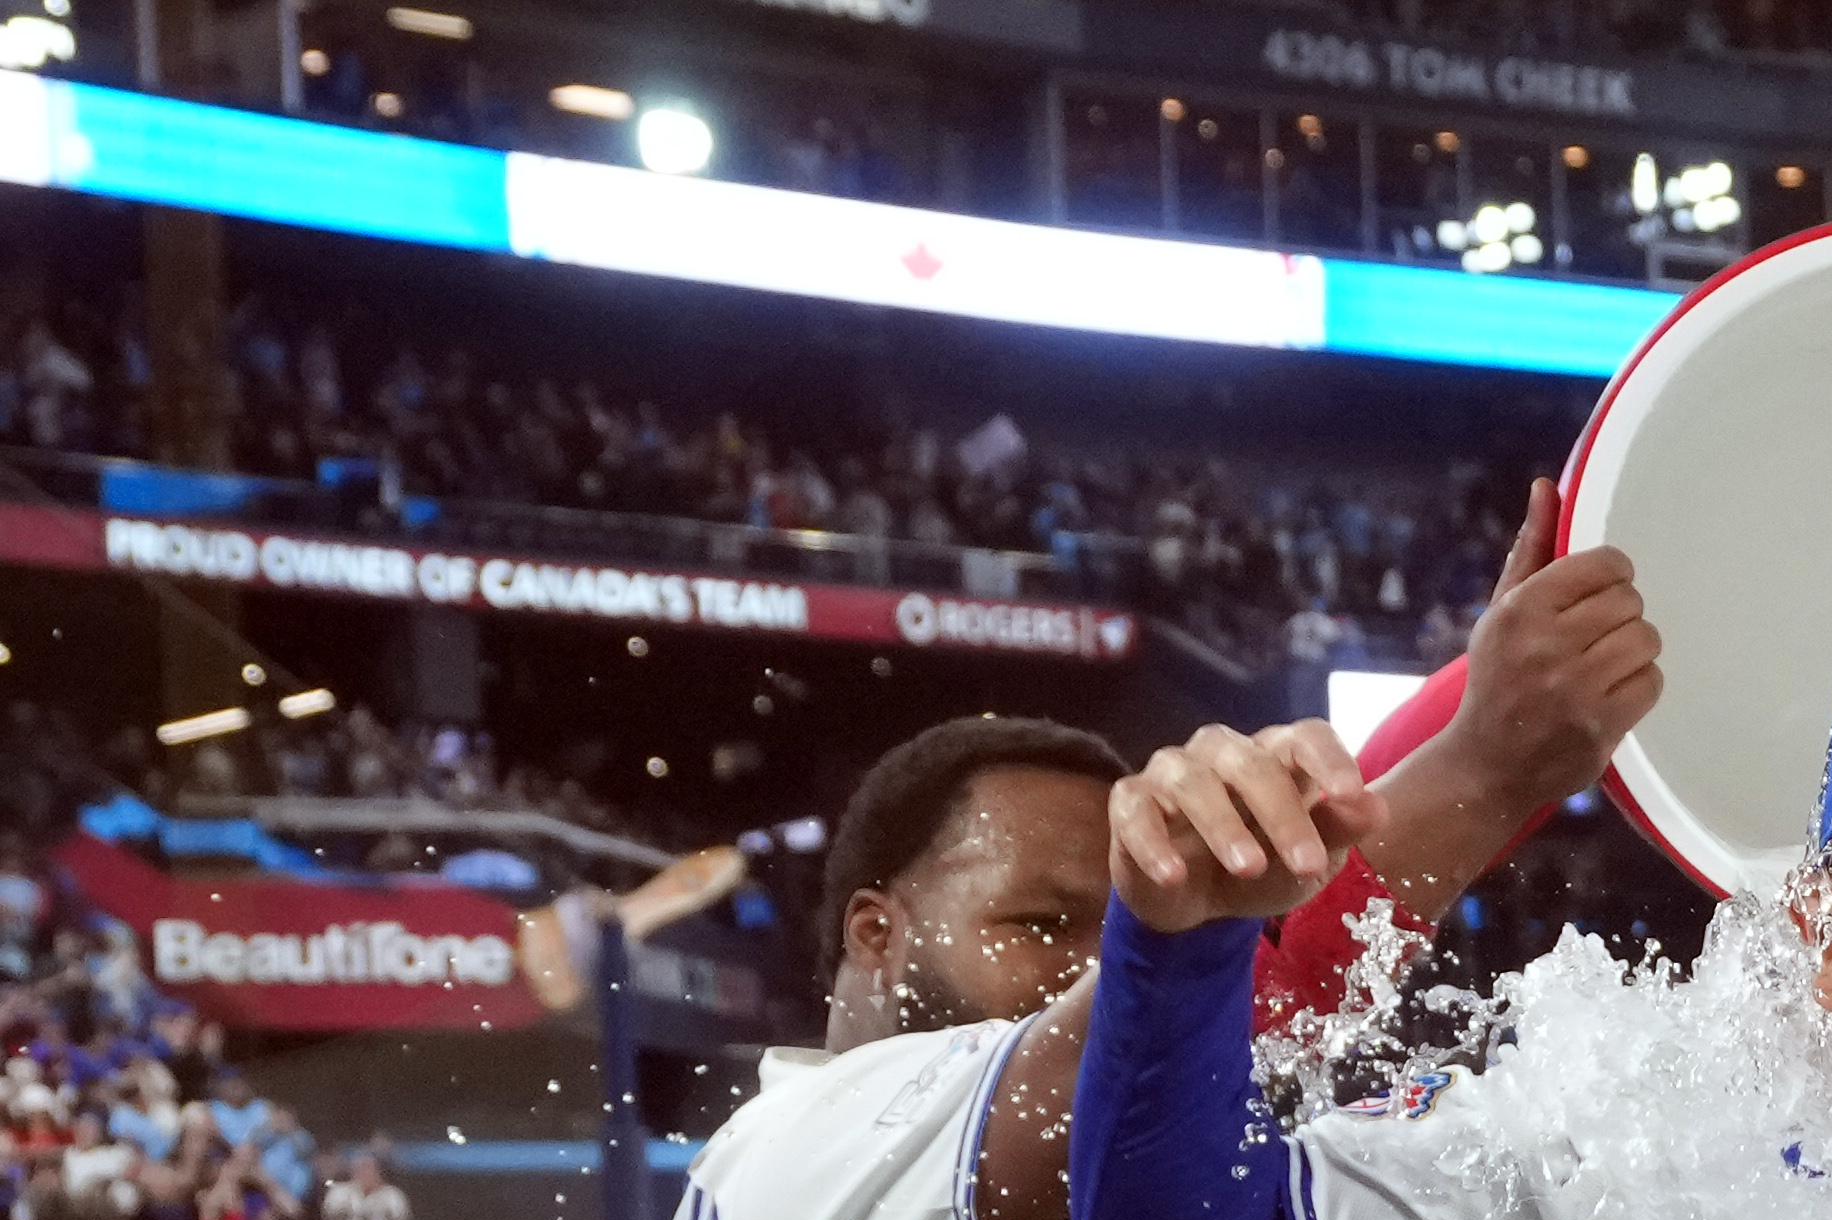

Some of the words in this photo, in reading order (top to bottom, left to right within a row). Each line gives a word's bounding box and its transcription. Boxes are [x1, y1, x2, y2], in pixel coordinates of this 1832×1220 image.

[1383, 41, 1489, 97] TOM
[1494, 55, 1635, 118] CHEEK
[104, 517, 258, 580] PROUD
[260, 535, 416, 598] OWNER
[417, 553, 478, 603] OF
[480, 558, 692, 623] CANADA'S
[693, 577, 809, 632] TEAM
[939, 600, 1081, 651] ROGERS
[153, 918, 512, 986] BeautiTone
